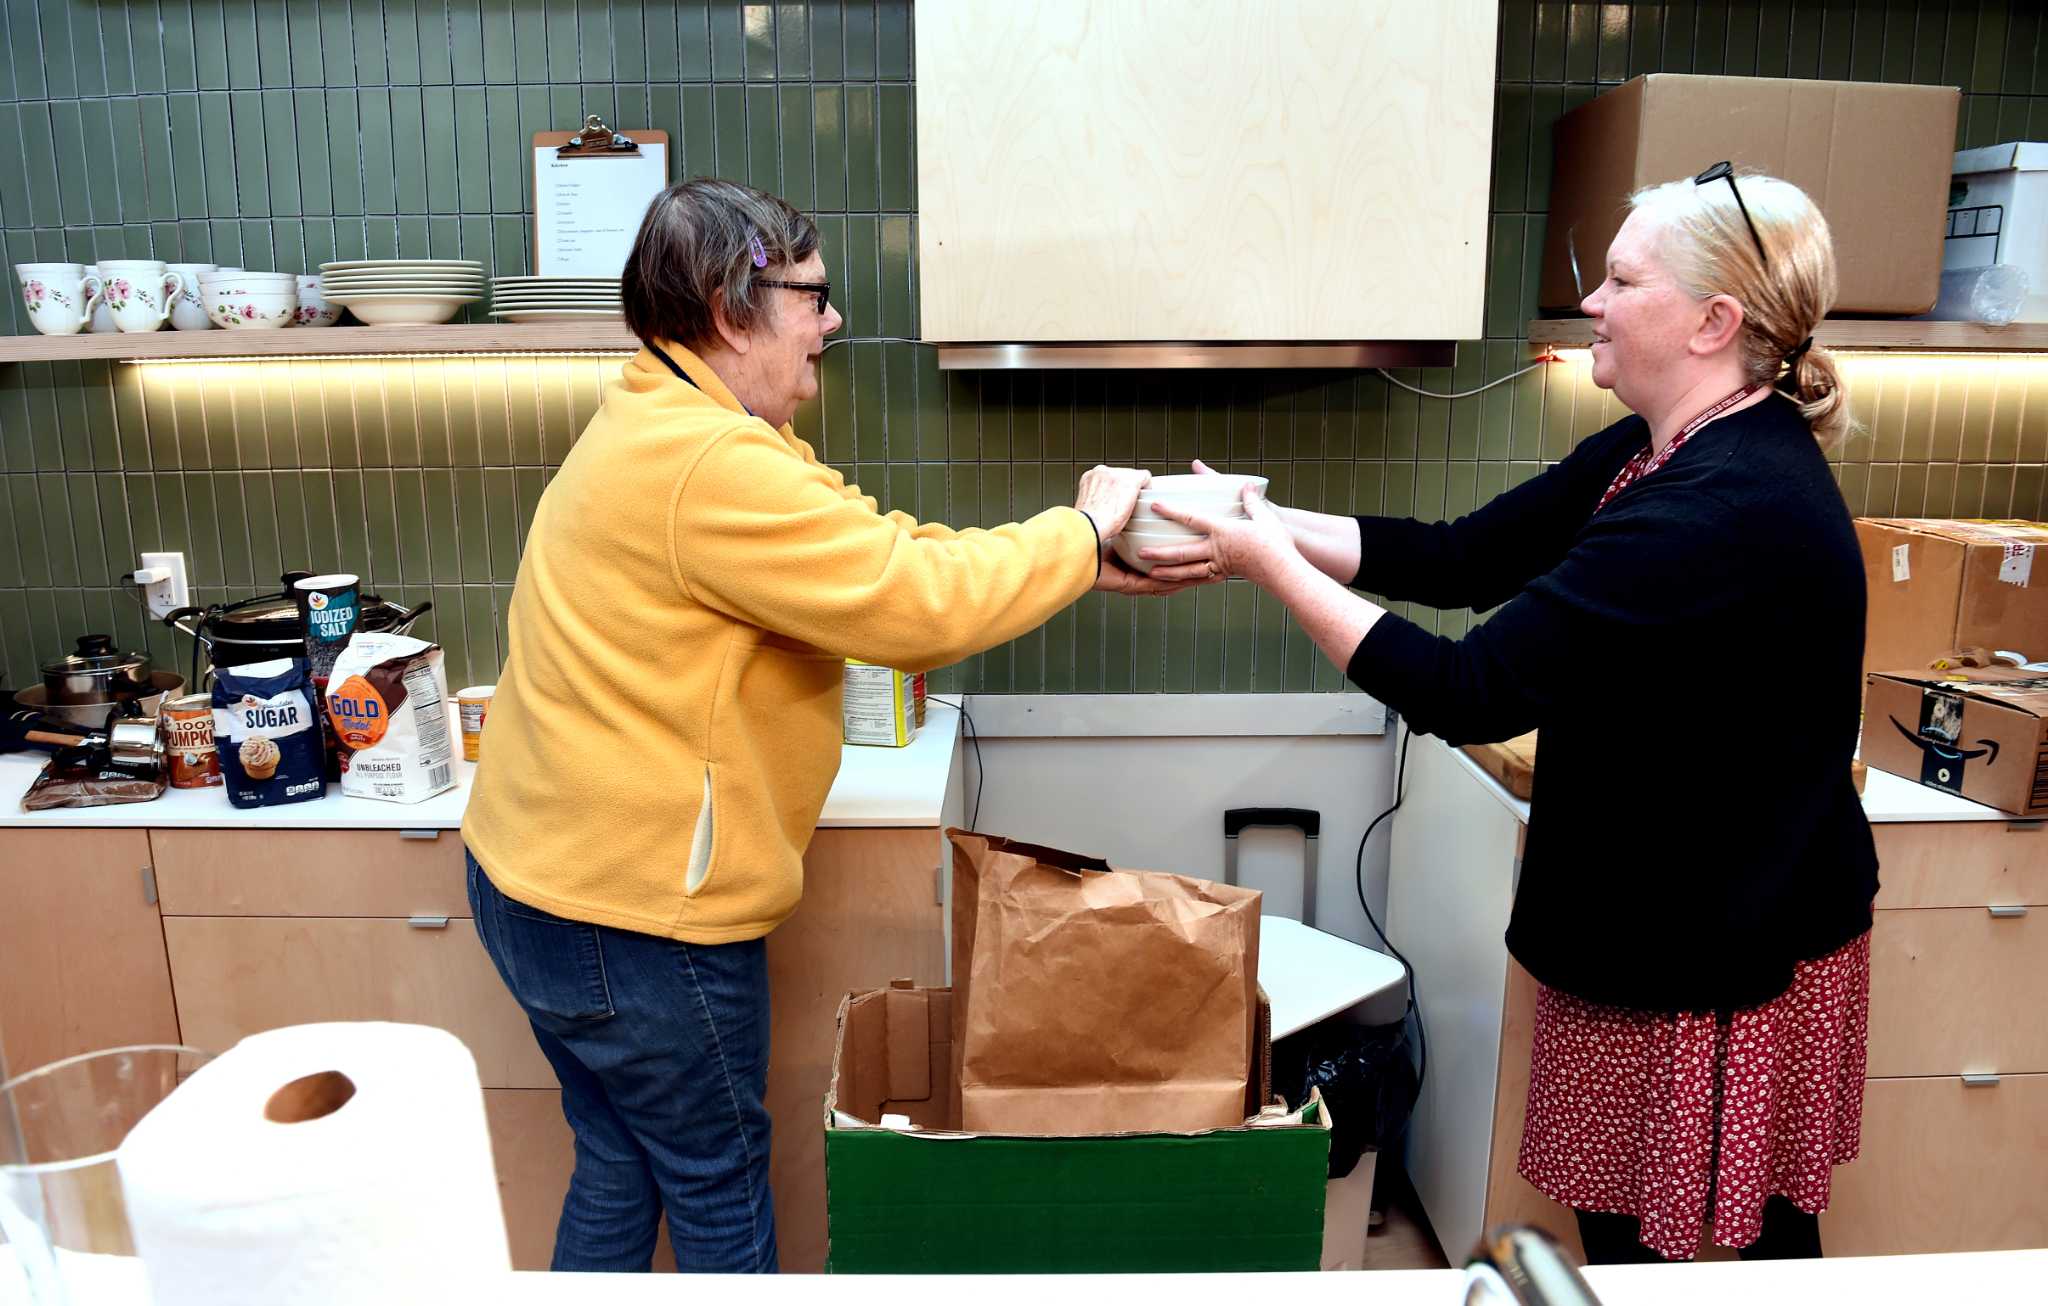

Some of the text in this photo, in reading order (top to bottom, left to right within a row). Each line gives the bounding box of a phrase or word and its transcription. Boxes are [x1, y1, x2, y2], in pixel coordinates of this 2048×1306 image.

[310, 607, 353, 624] IODIZED
[320, 621, 347, 637] SALT
[331, 694, 380, 718] GOLD
[246, 706, 299, 728] SUGAR
[167, 730, 214, 747] PUMPKI
[356, 763, 402, 772] UNBLEACHED
